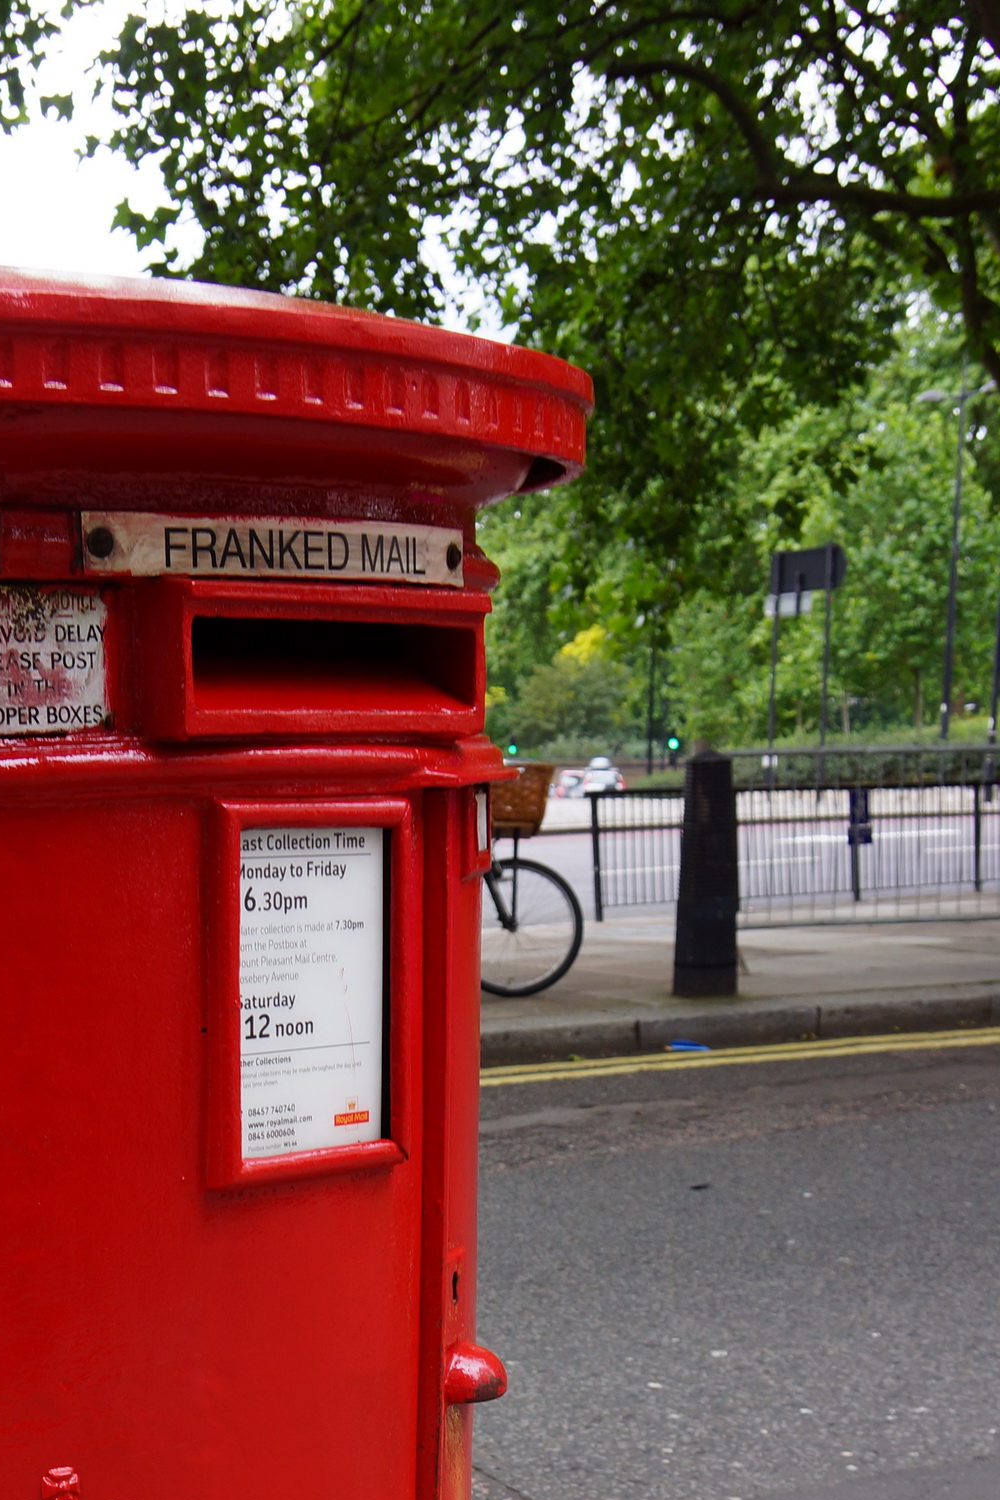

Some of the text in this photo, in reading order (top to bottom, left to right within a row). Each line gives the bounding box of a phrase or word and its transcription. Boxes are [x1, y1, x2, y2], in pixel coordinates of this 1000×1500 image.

[163, 526, 427, 576] FRANKED MAIL
[54, 624, 107, 644] DELAY
[51, 651, 97, 671] POST
[46, 704, 103, 725] BOXES
[240, 831, 366, 852] ast Collection Time
[289, 862, 303, 878] to
[306, 860, 348, 880] Friday
[243, 885, 309, 915] 6.30pm
[240, 925, 259, 937] later
[260, 924, 297, 936] collection
[304, 921, 325, 933] made
[326, 919, 334, 931] at
[335, 919, 365, 932] 7.30pm
[240, 938, 308, 952] om the Postbox at
[240, 957, 259, 969] ount
[260, 954, 294, 968] Pleasant
[294, 953, 310, 965] Mail
[239, 971, 300, 985] osebery Avenue
[244, 1013, 272, 1040] 12
[275, 1020, 315, 1038] noon
[255, 1054, 292, 1067] Collections
[247, 1103, 296, 1118] 08457 740740
[335, 1111, 369, 1126] Royal Mail
[247, 1114, 313, 1130] www.royalmail.com
[247, 1130, 265, 1142] 0845
